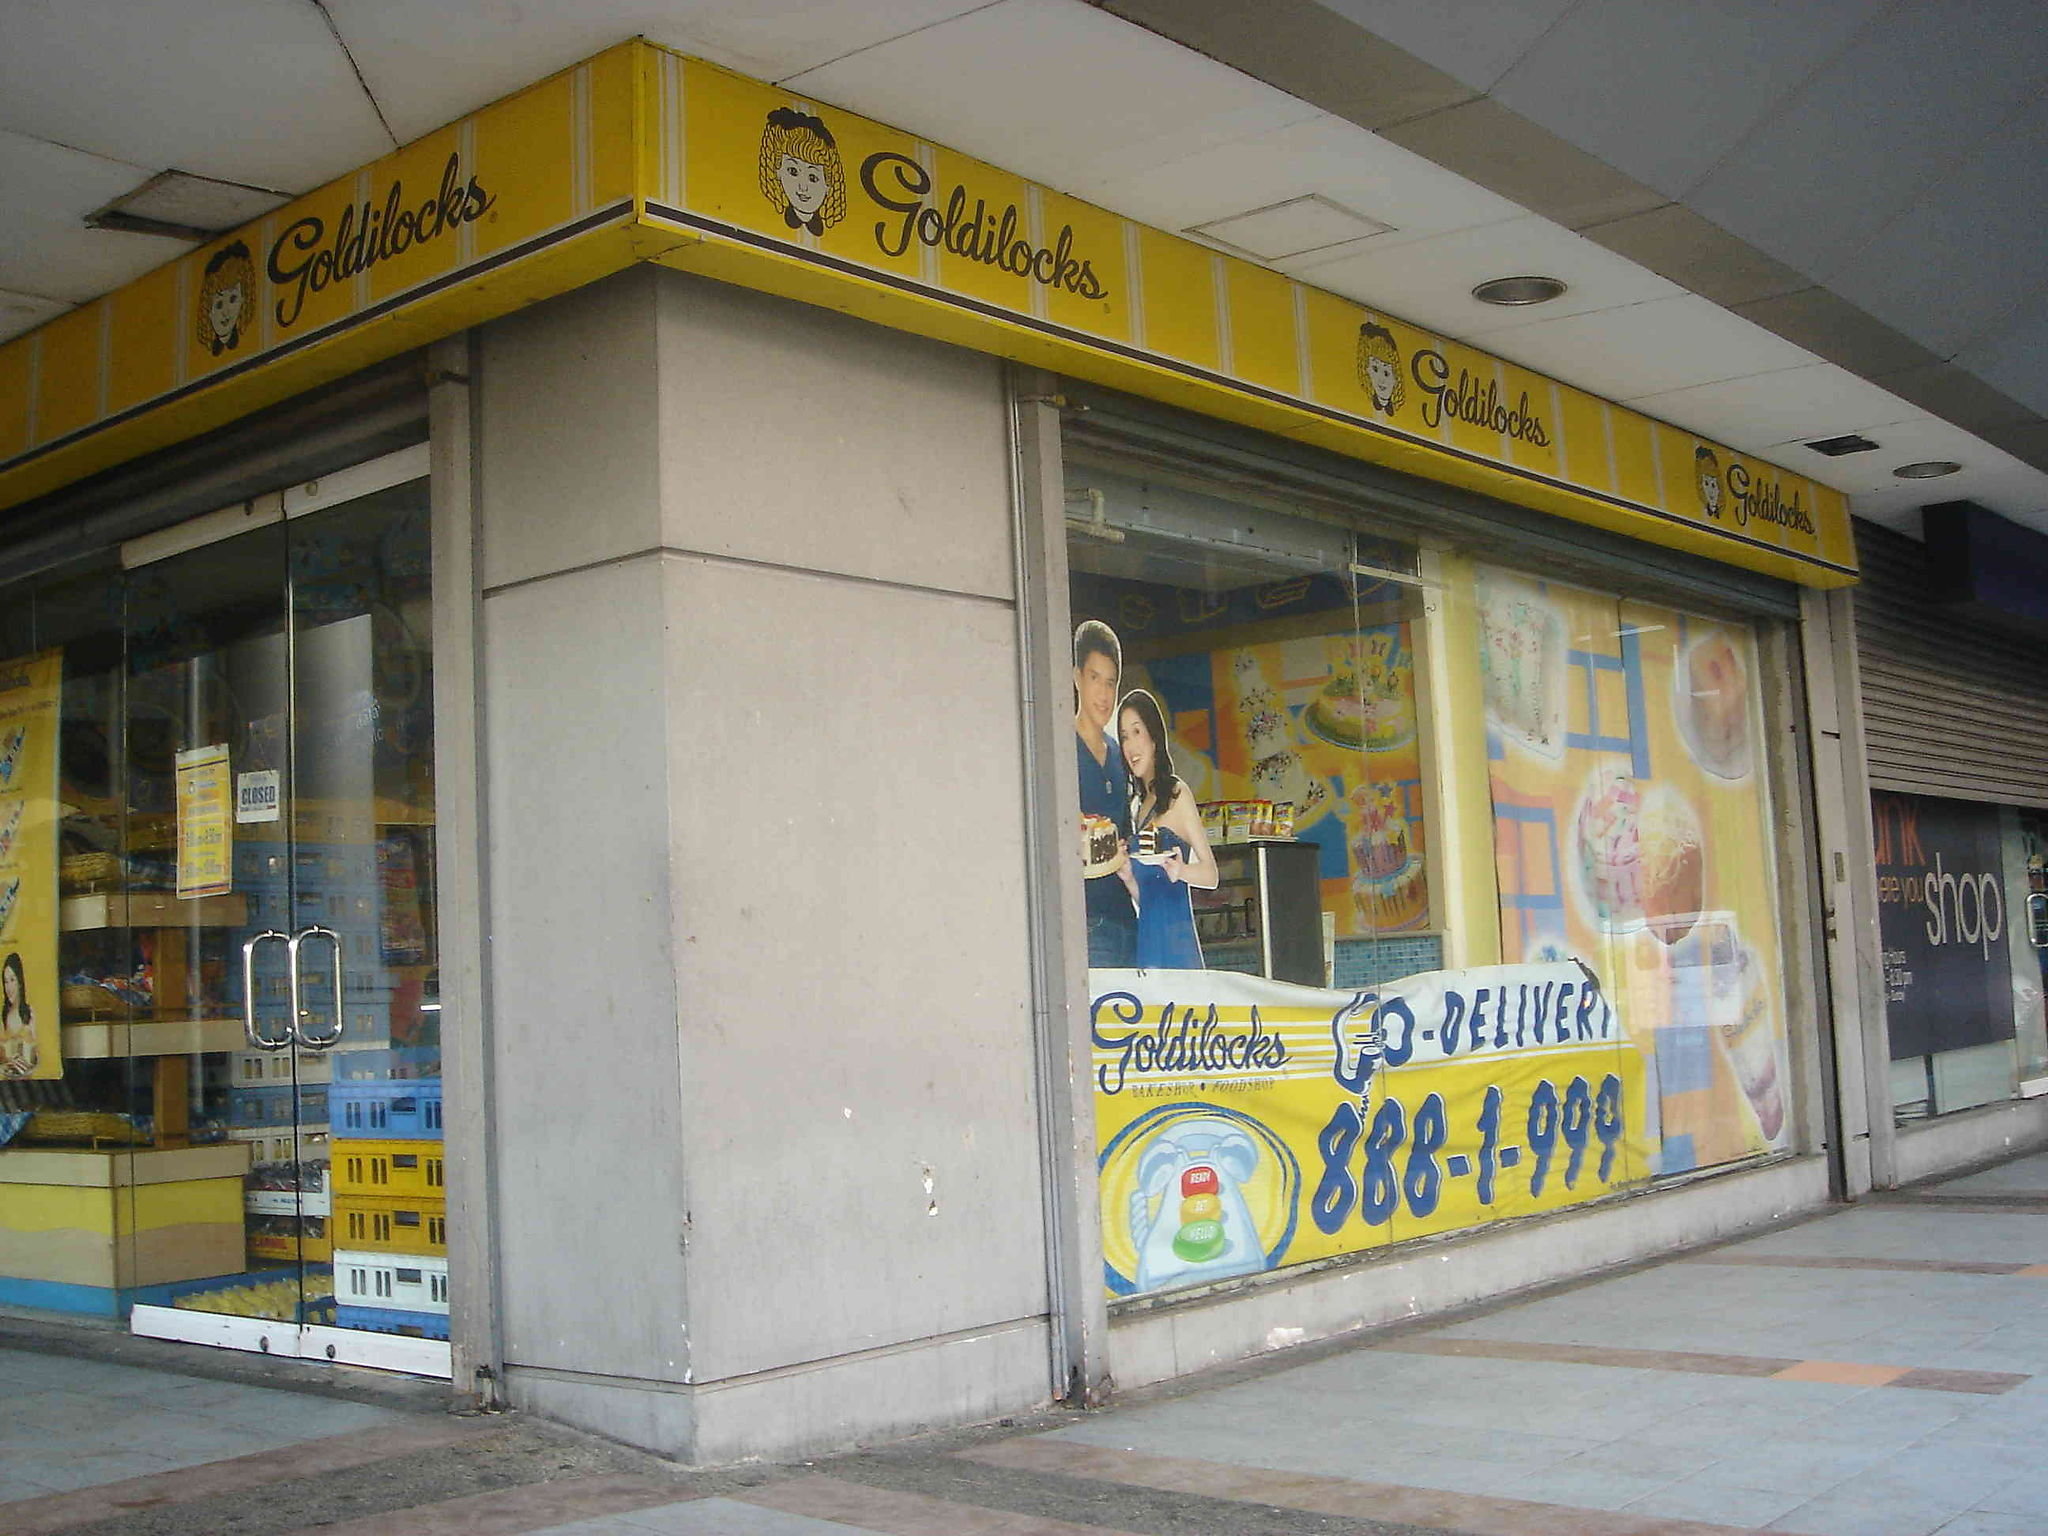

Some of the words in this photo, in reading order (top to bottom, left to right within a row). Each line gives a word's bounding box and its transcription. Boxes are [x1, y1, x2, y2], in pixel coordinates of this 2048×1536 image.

[267, 152, 497, 328] Goldilocks
[860, 152, 1108, 299] Goldilocks
[1412, 349, 1551, 447] Goldilocks
[1727, 464, 1815, 535] Goldilocks
[241, 785, 276, 805] CLOSED
[1924, 852, 2002, 961] shop
[1090, 991, 1293, 1095] Goldilocks
[1131, 1081, 1196, 1098] BAKESHOP
[1211, 1079, 1276, 1094] FOODSHOP
[1311, 1073, 1622, 1235] 888-1-999
